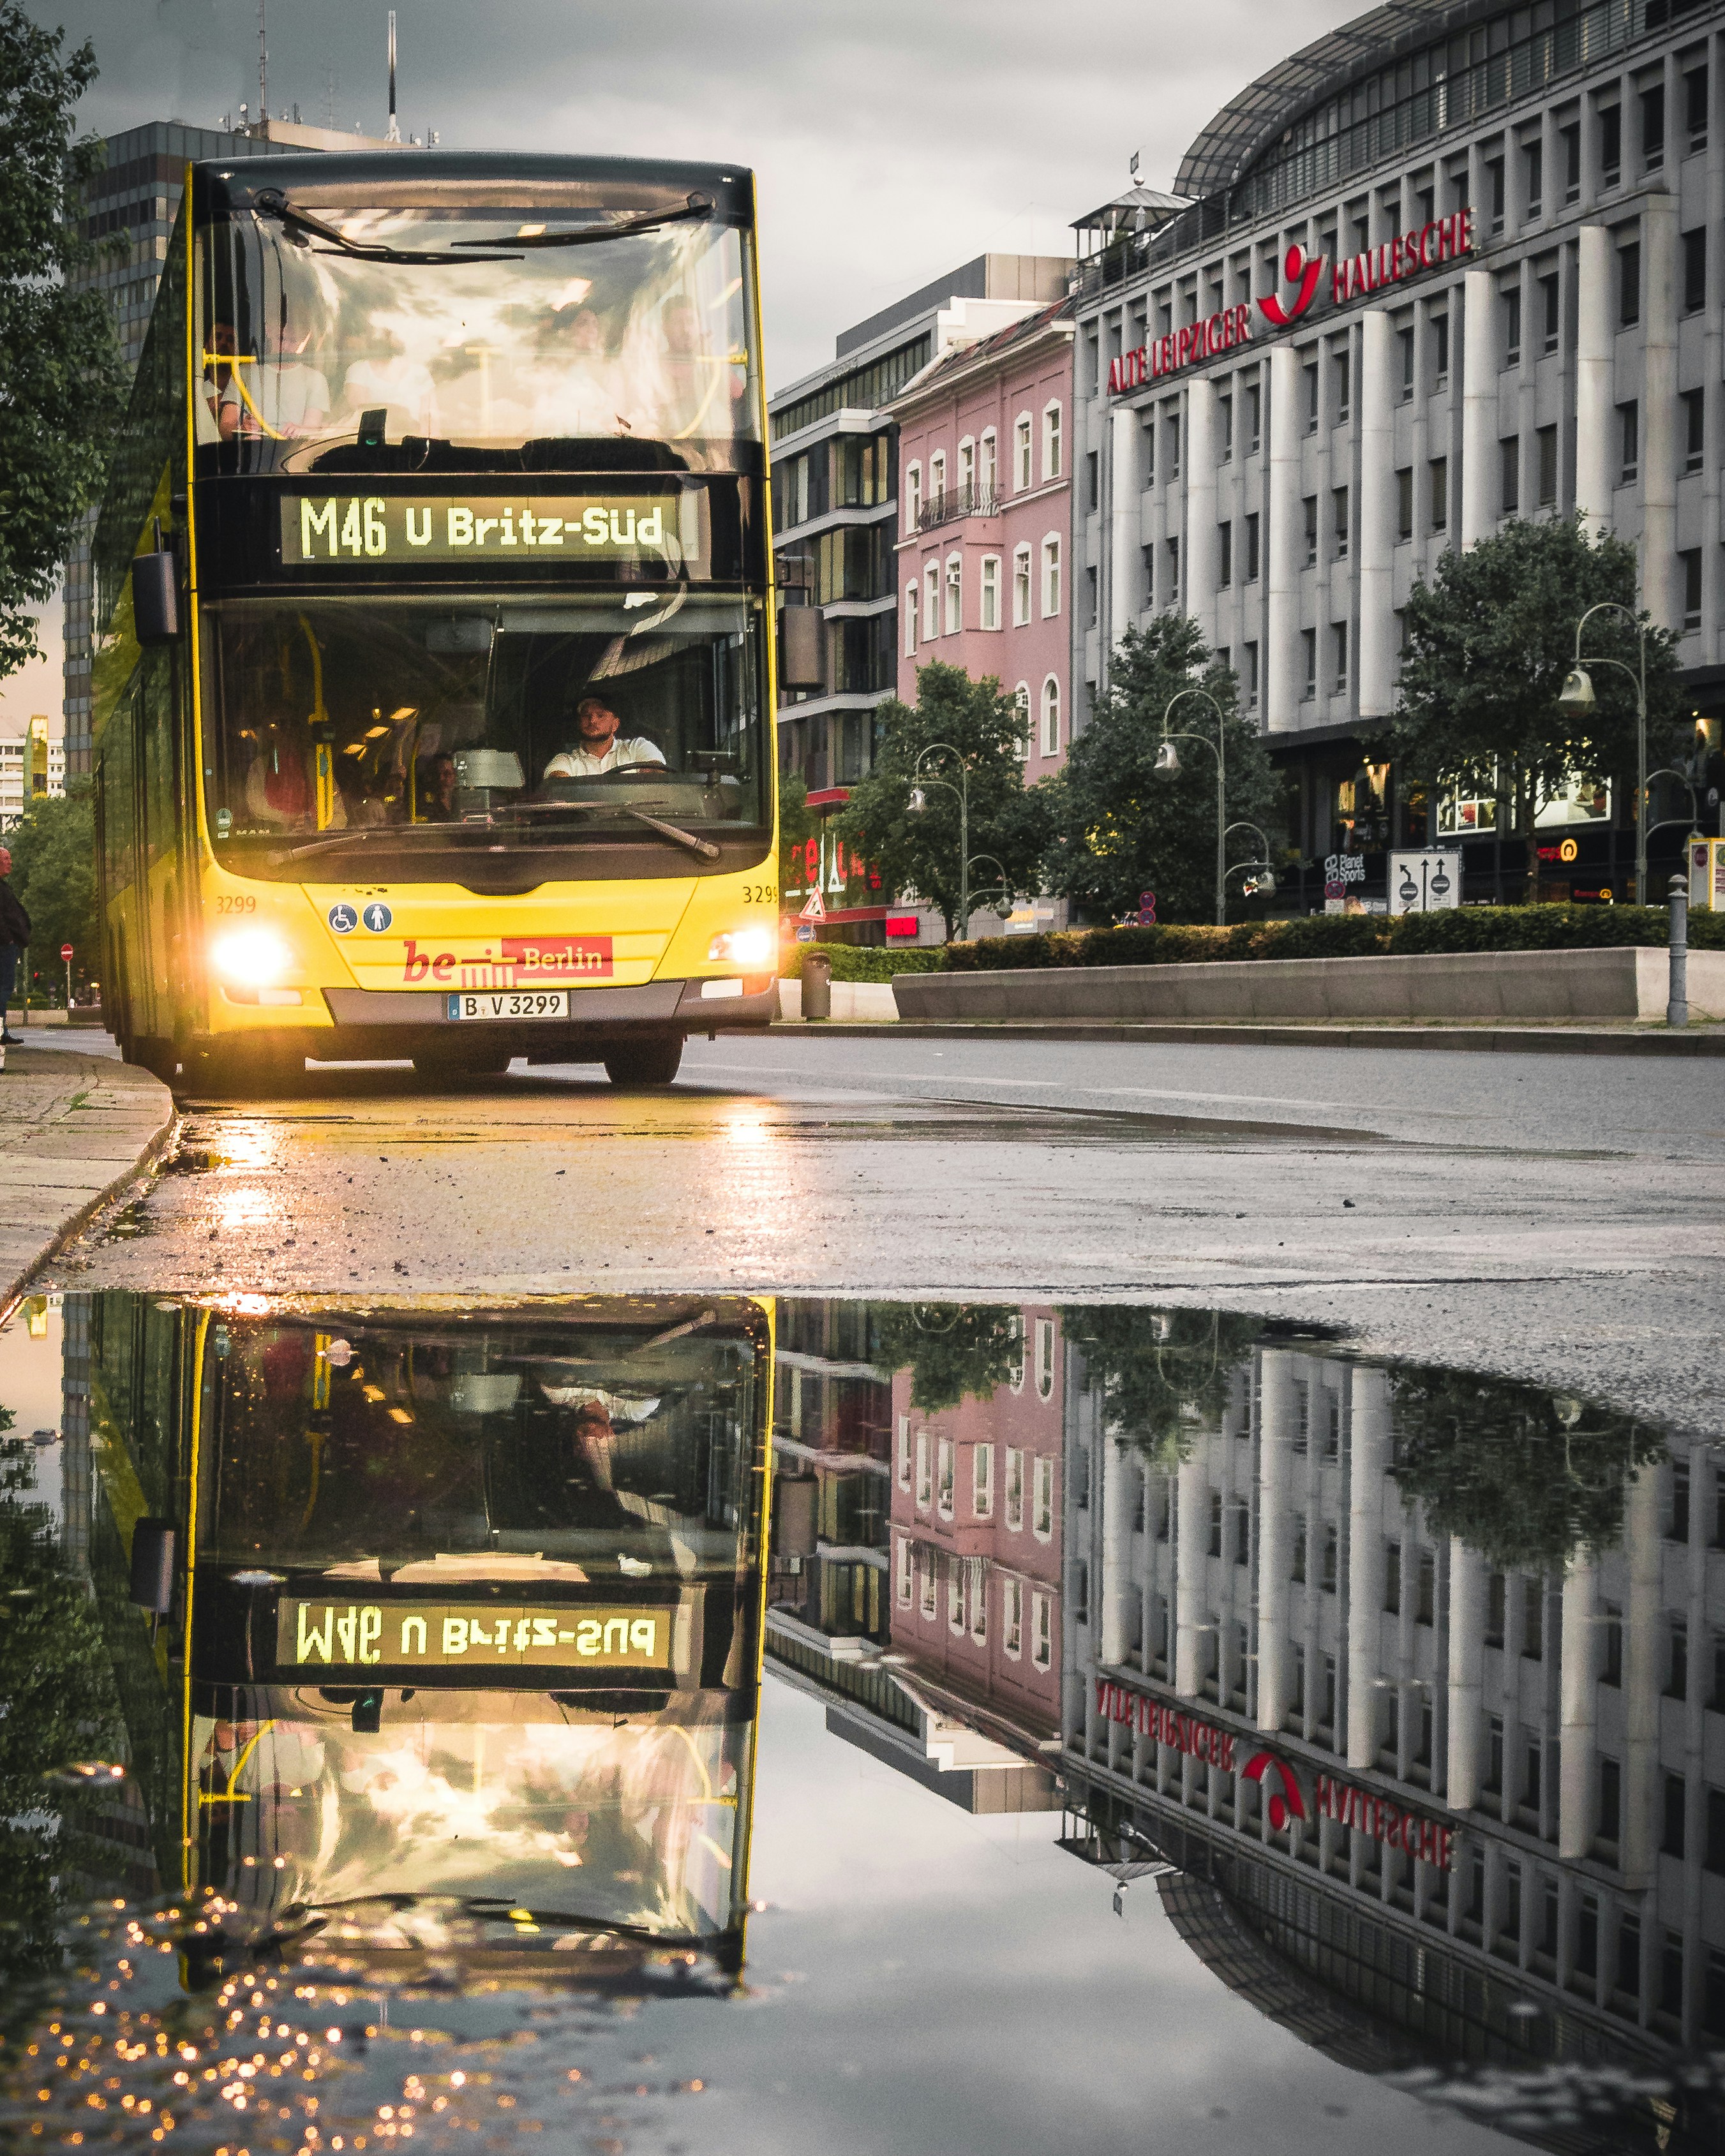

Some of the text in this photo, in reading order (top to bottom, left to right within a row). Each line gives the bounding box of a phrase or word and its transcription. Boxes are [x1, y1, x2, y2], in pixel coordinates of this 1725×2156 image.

[1107, 207, 1478, 396] ALTE LEIPZIGER HALLESCHE
[301, 497, 663, 557] M46 U Britz-Süd
[1340, 867, 1366, 886] Sports
[216, 895, 257, 914] 3299
[743, 886, 778, 903] 3299
[403, 940, 603, 982] be Berlin
[465, 997, 477, 1016] B
[491, 997, 504, 1015] V
[509, 995, 561, 1015] 3299
